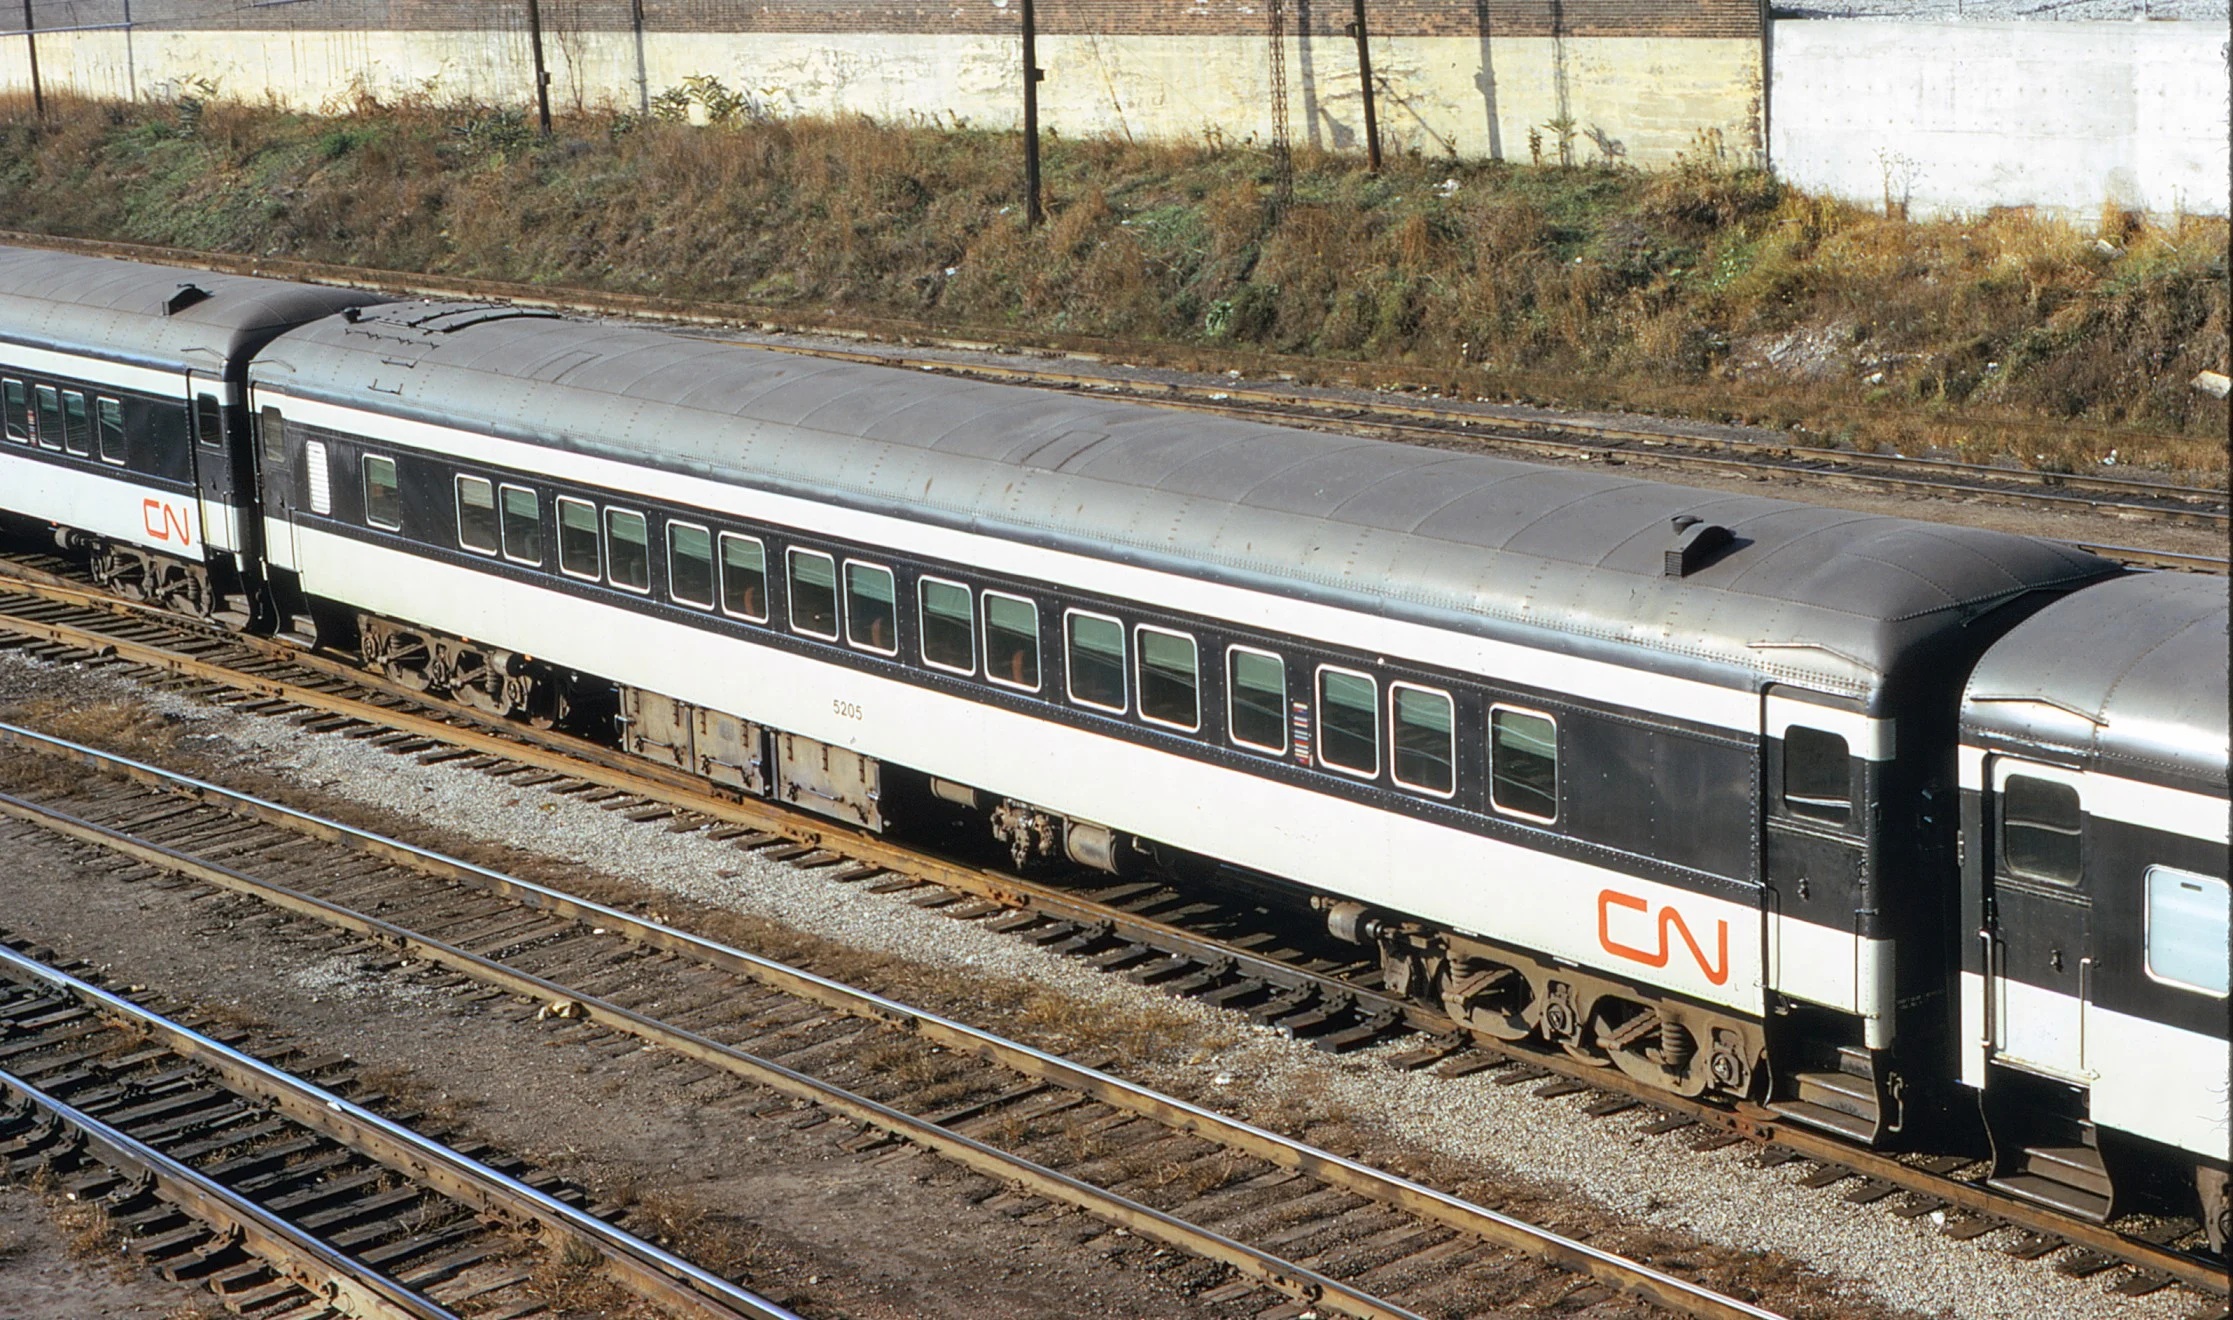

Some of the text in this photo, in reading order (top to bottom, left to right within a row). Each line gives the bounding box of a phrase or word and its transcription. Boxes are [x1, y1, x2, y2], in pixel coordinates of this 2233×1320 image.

[143, 498, 190, 547] CN
[833, 699, 863, 721] 5205
[1597, 888, 1729, 987] CN
